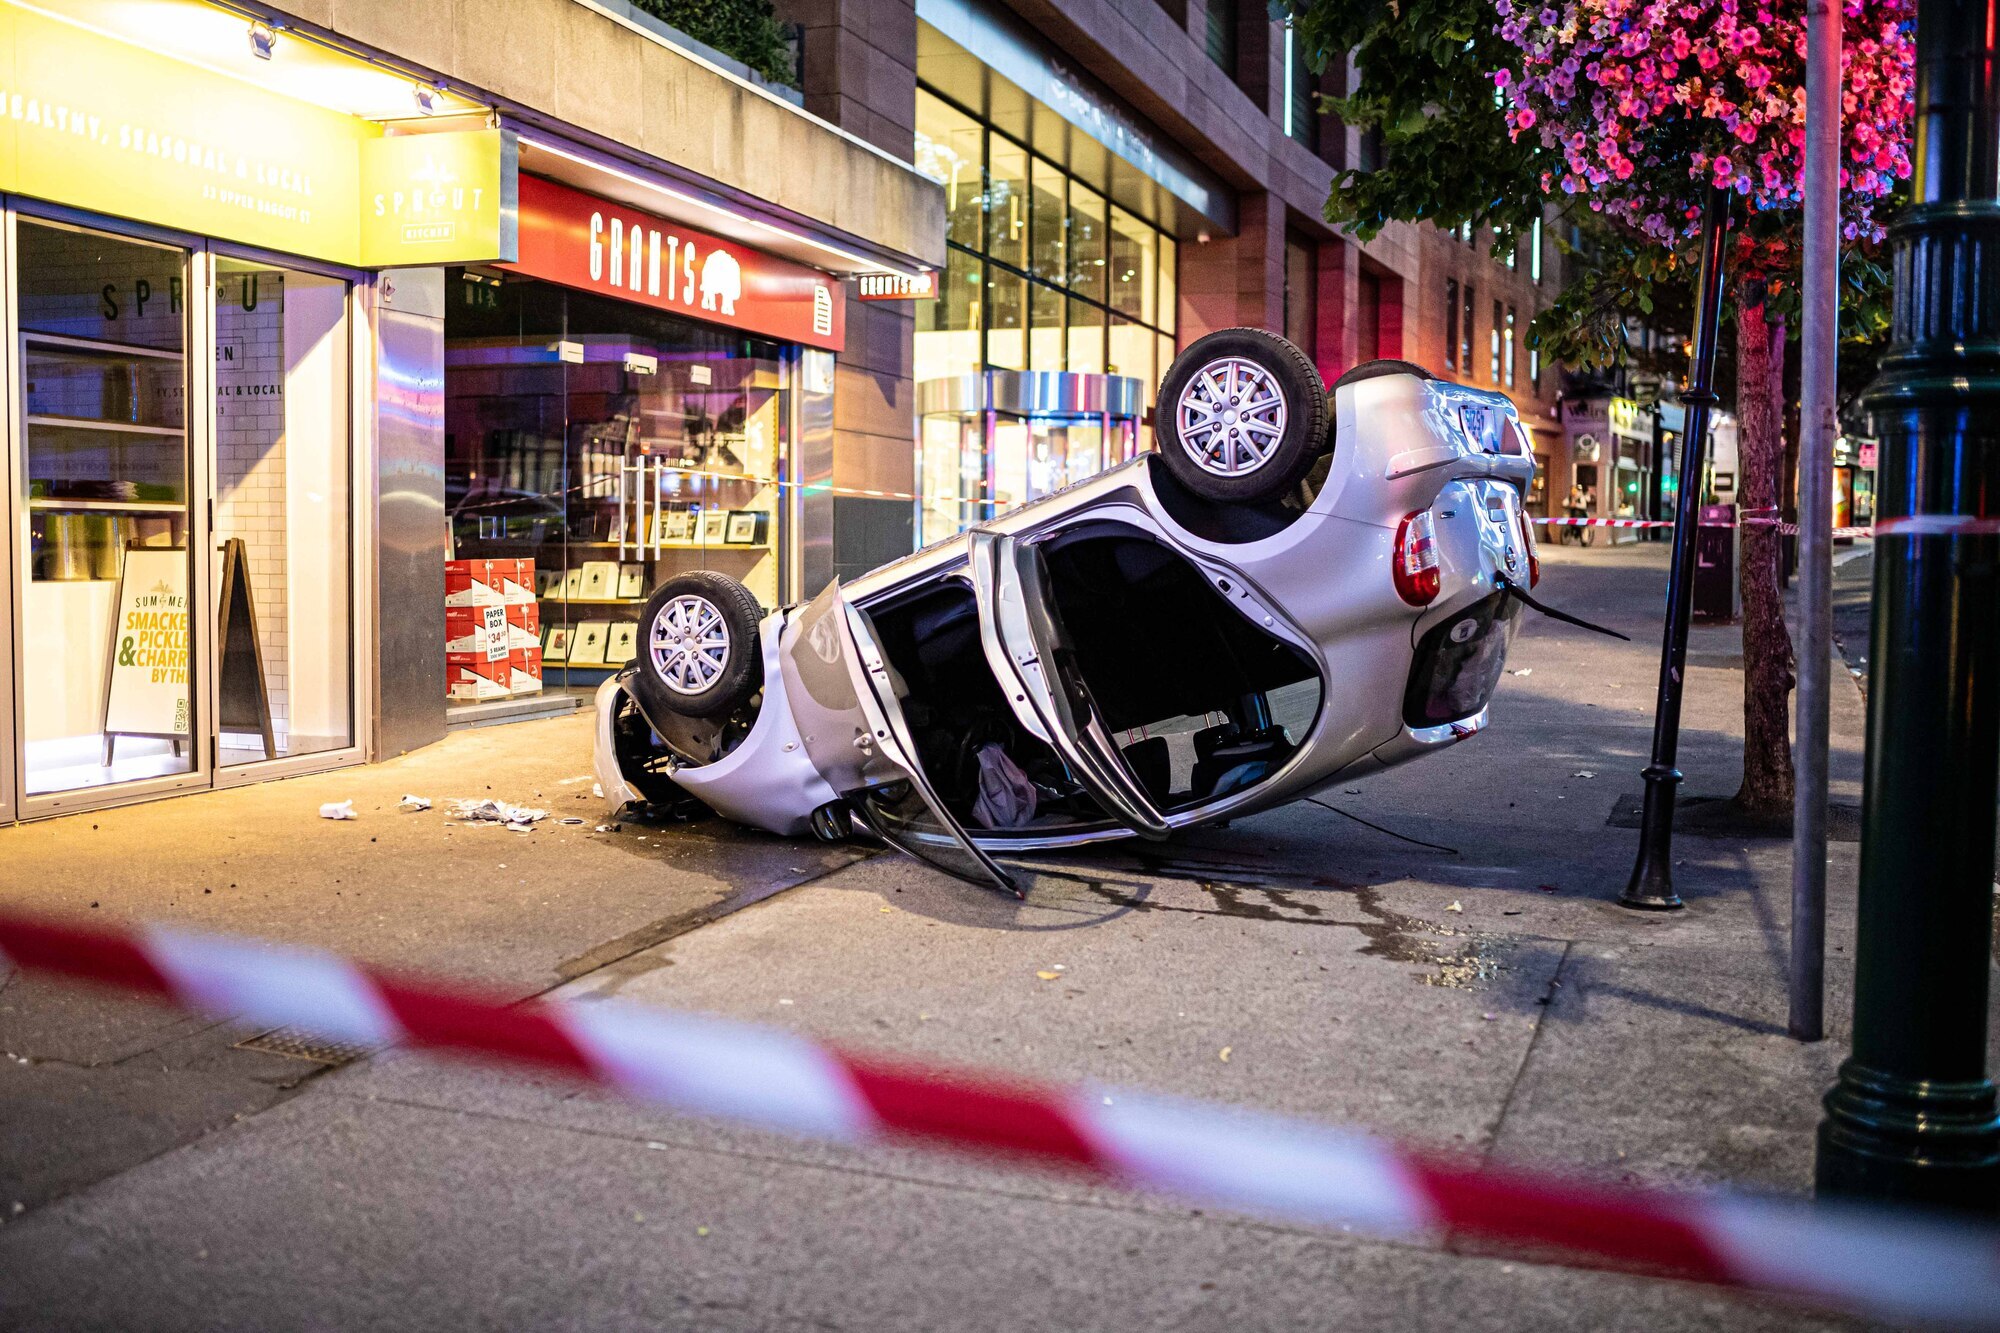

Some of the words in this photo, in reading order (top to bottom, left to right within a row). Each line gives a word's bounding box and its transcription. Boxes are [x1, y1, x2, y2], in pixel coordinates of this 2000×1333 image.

[119, 123, 227, 174] SEASONAL
[256, 161, 313, 197] LOCAL
[220, 188, 254, 210] UPPER
[256, 199, 297, 221] BAGGOT
[300, 207, 311, 225] ST
[404, 226, 450, 240] KITCHEN
[589, 211, 696, 306] GRANTS
[860, 276, 909, 296] GRANTS
[246, 384, 283, 396] LOCAL
[486, 608, 504, 619] PAPER
[489, 619, 503, 628] BOX
[118, 636, 137, 667] &
[151, 668, 167, 684] BY
